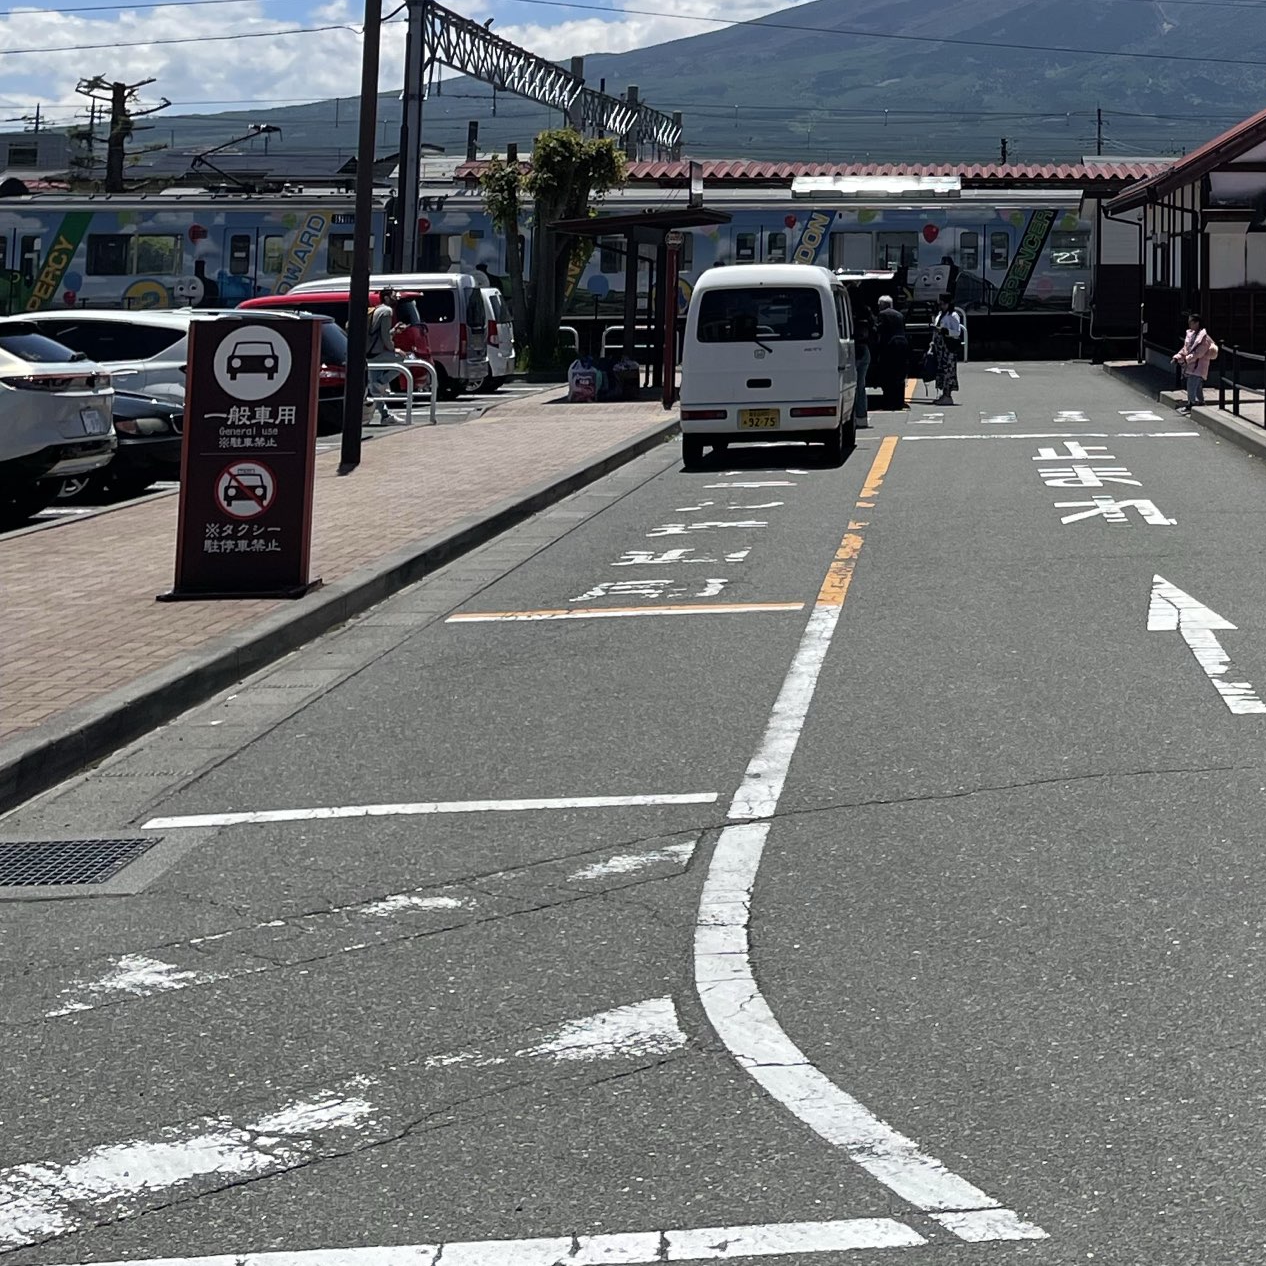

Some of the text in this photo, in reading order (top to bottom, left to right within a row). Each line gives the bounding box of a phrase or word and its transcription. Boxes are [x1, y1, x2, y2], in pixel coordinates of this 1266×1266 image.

[275, 213, 326, 296] DWARD
[793, 212, 831, 265] DON
[998, 210, 1055, 310] SPENCER
[25, 233, 75, 312] PERCY
[203, 405, 297, 426] 一般車用
[219, 426, 279, 436] General use
[203, 539, 282, 553] 駐停車禁止
